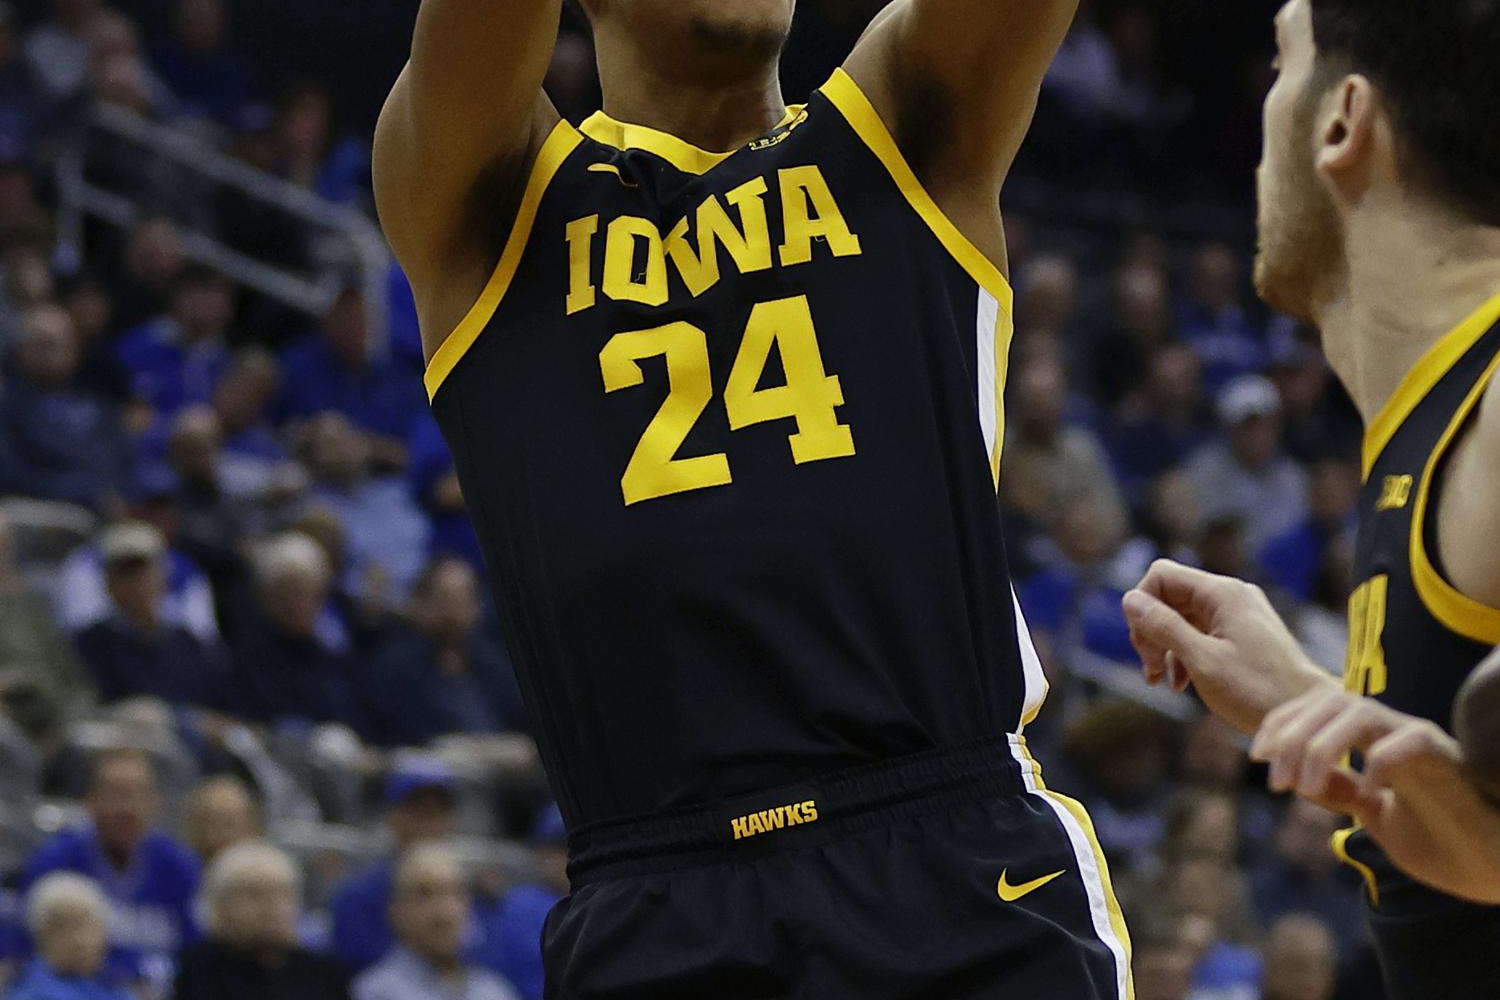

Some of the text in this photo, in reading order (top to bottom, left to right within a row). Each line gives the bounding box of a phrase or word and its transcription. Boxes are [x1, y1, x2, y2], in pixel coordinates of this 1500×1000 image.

[565, 164, 862, 316] IOWA
[598, 294, 857, 507] 24
[731, 800, 819, 840] HAWKS
